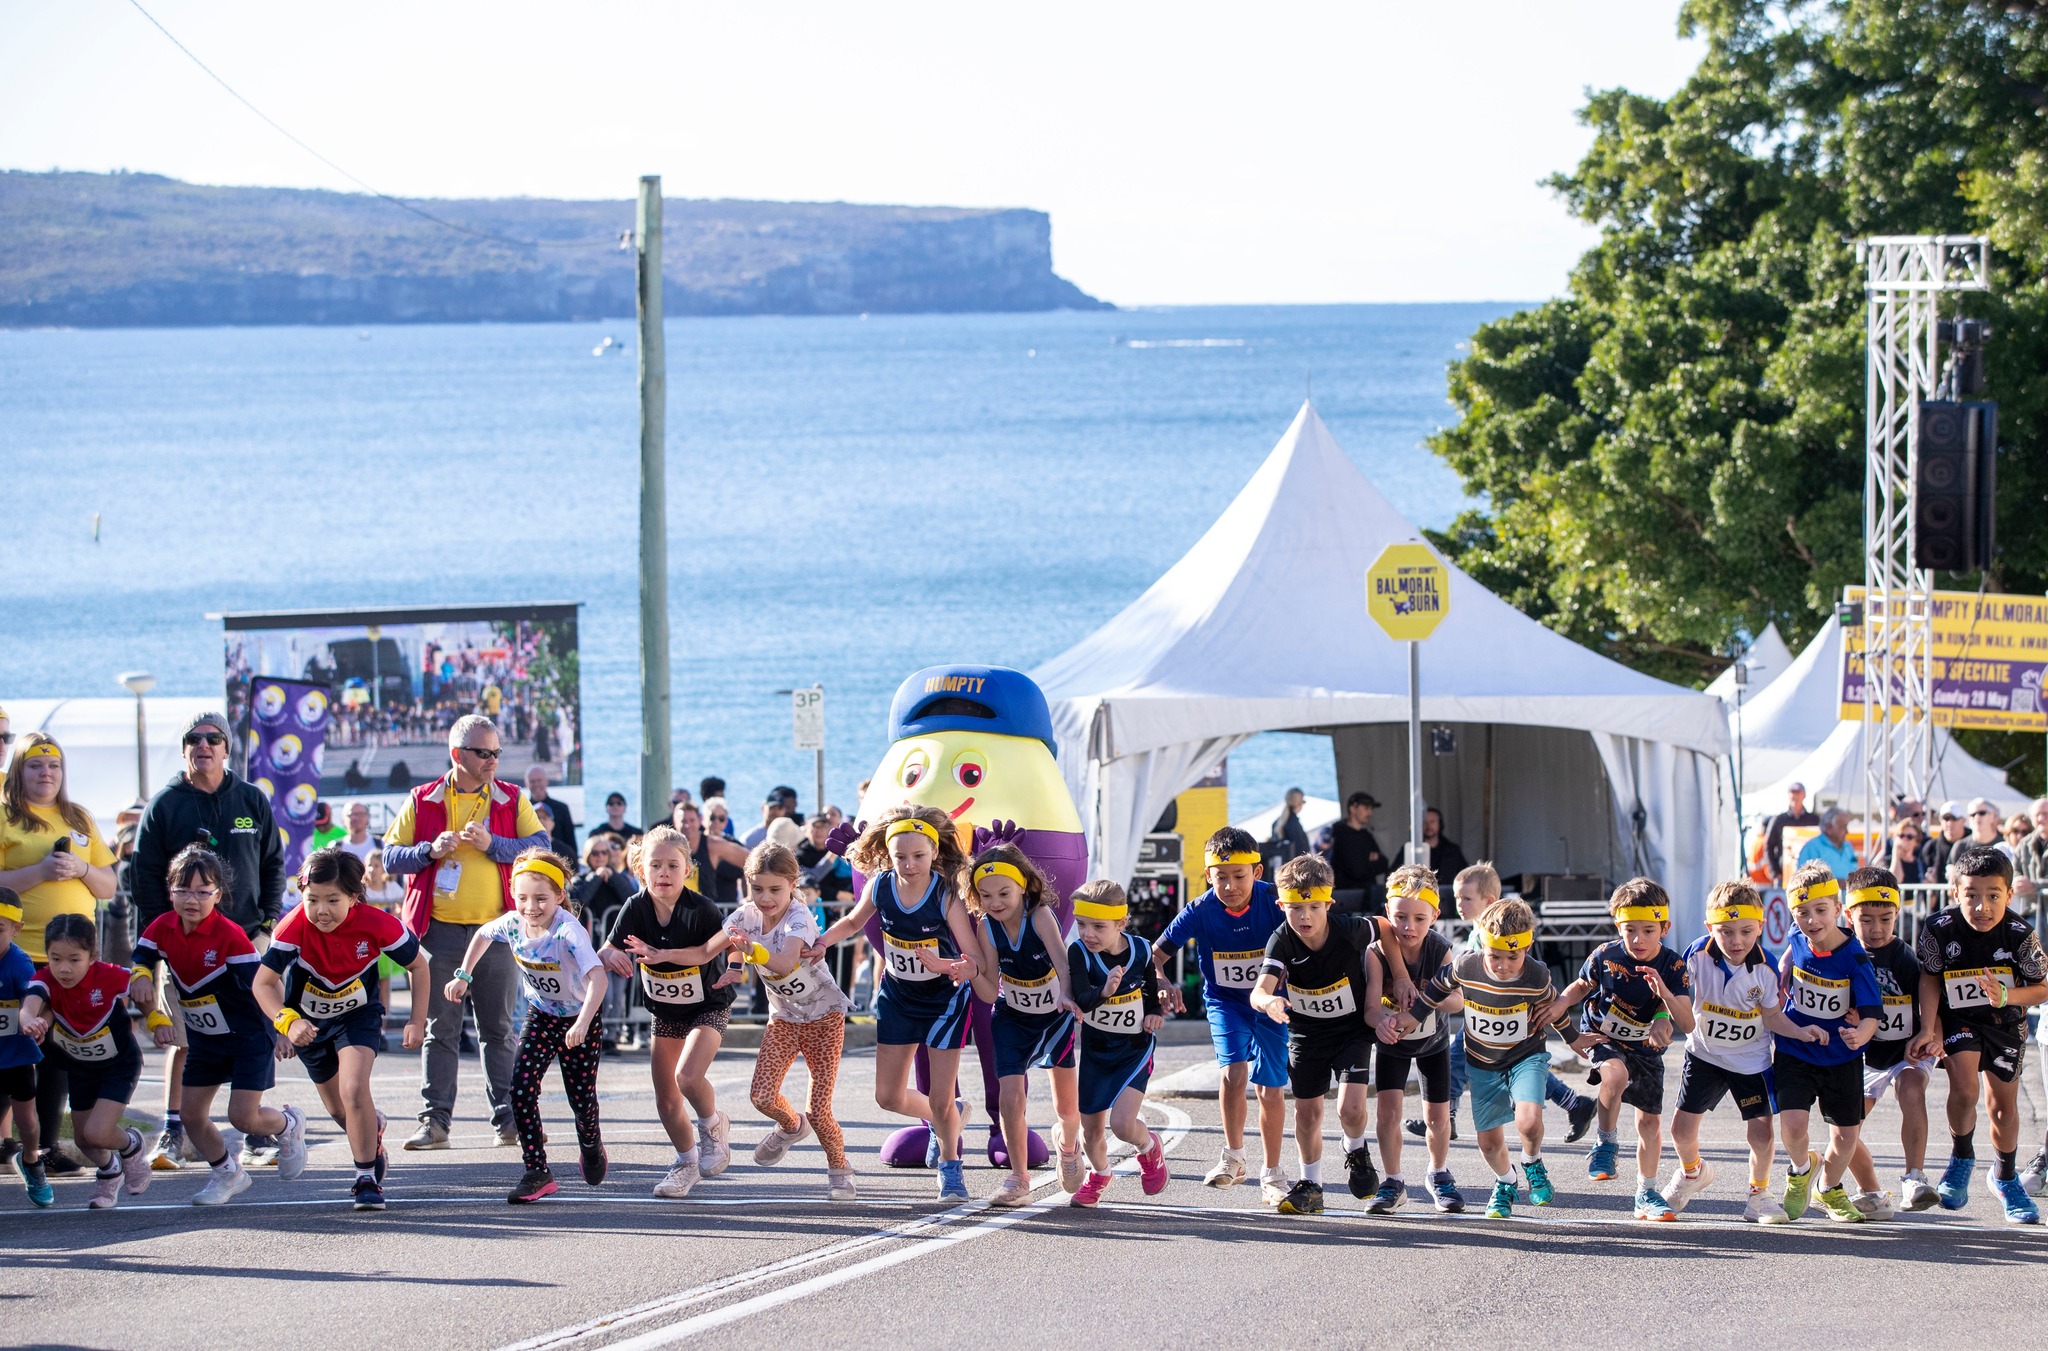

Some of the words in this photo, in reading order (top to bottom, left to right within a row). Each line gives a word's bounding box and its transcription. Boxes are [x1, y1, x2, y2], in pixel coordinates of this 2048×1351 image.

[1376, 577, 1439, 594] BALMORAL
[1409, 594, 1440, 612] BURN
[1949, 661, 2011, 683] SPECTATE
[924, 676, 986, 693] HUMPTY
[796, 692, 821, 708] 3P
[1987, 691, 2009, 710] May
[1218, 952, 1248, 960] BALMORAL
[1221, 964, 1264, 983] 136
[1949, 970, 1981, 979] BALMORAL
[646, 979, 695, 998] 1298
[1321, 985, 1336, 995] BURN
[1820, 980, 1835, 988] BURN
[309, 987, 338, 999] BALMORAL
[1010, 988, 1055, 1008] 1374
[1798, 986, 1841, 1012] 1376
[309, 998, 358, 1014] 1359
[1298, 995, 1344, 1013] 1481
[1468, 1001, 1497, 1015] BALMORAL
[1498, 1007, 1514, 1015] BURN
[1708, 1004, 1737, 1018] BALMORAL
[1090, 1008, 1137, 1028] 1278
[1470, 1015, 1519, 1037] 1299
[1610, 1021, 1650, 1038] 183
[1707, 1019, 1757, 1042] 1250
[60, 1040, 107, 1057] 1353
